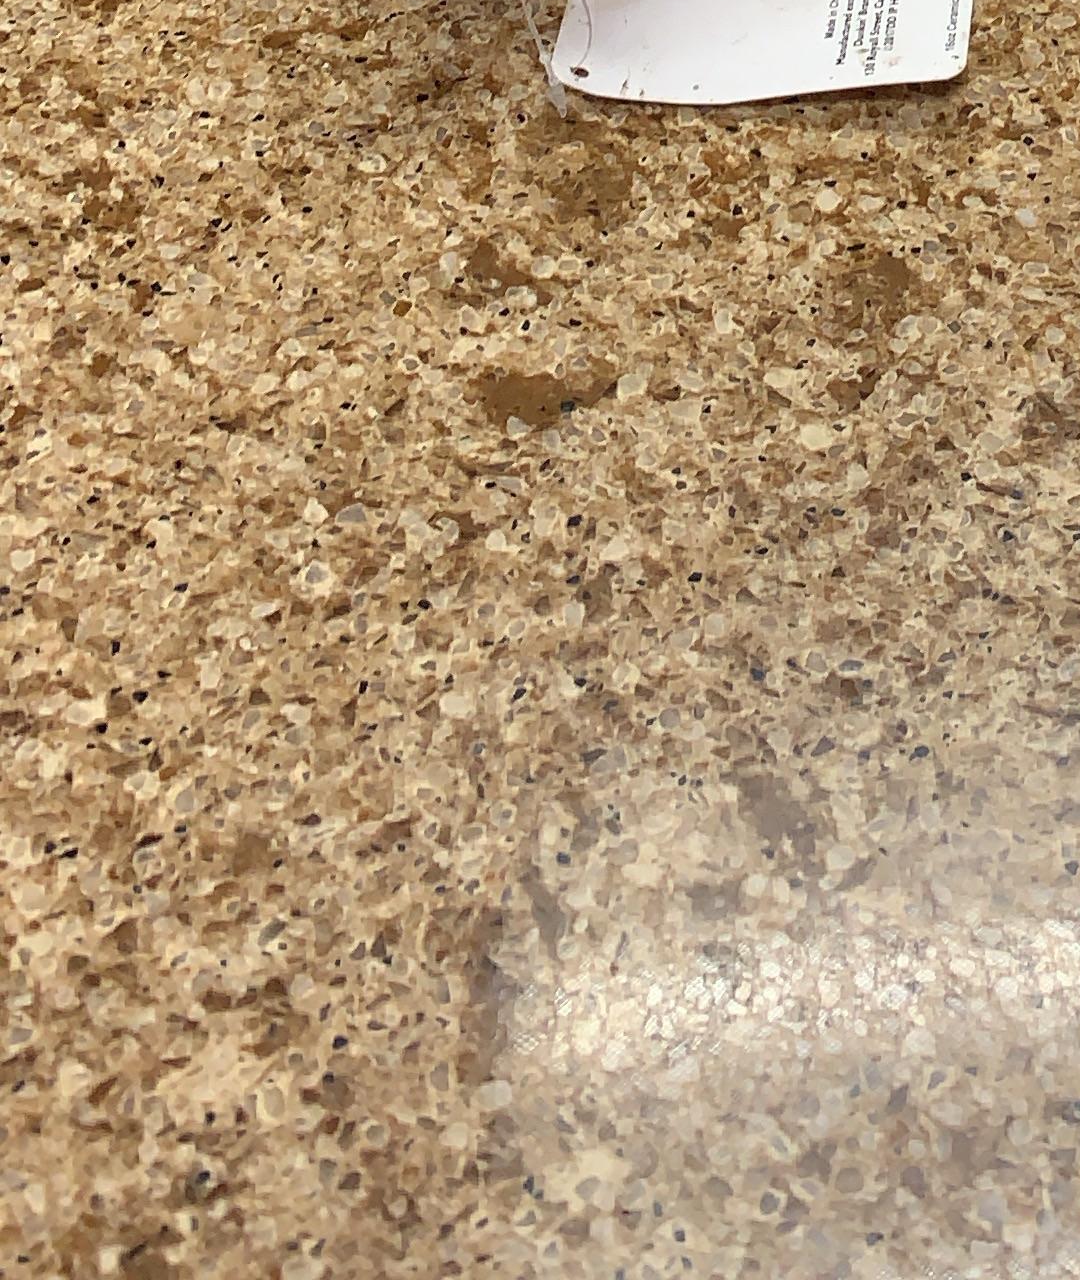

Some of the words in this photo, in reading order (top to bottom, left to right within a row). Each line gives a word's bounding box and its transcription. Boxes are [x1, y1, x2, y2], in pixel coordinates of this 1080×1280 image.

[824, 19, 835, 39] Made
[947, 0, 960, 31] Ceramic
[836, 13, 852, 65] Manufactured
[867, 37, 881, 61] Royall
